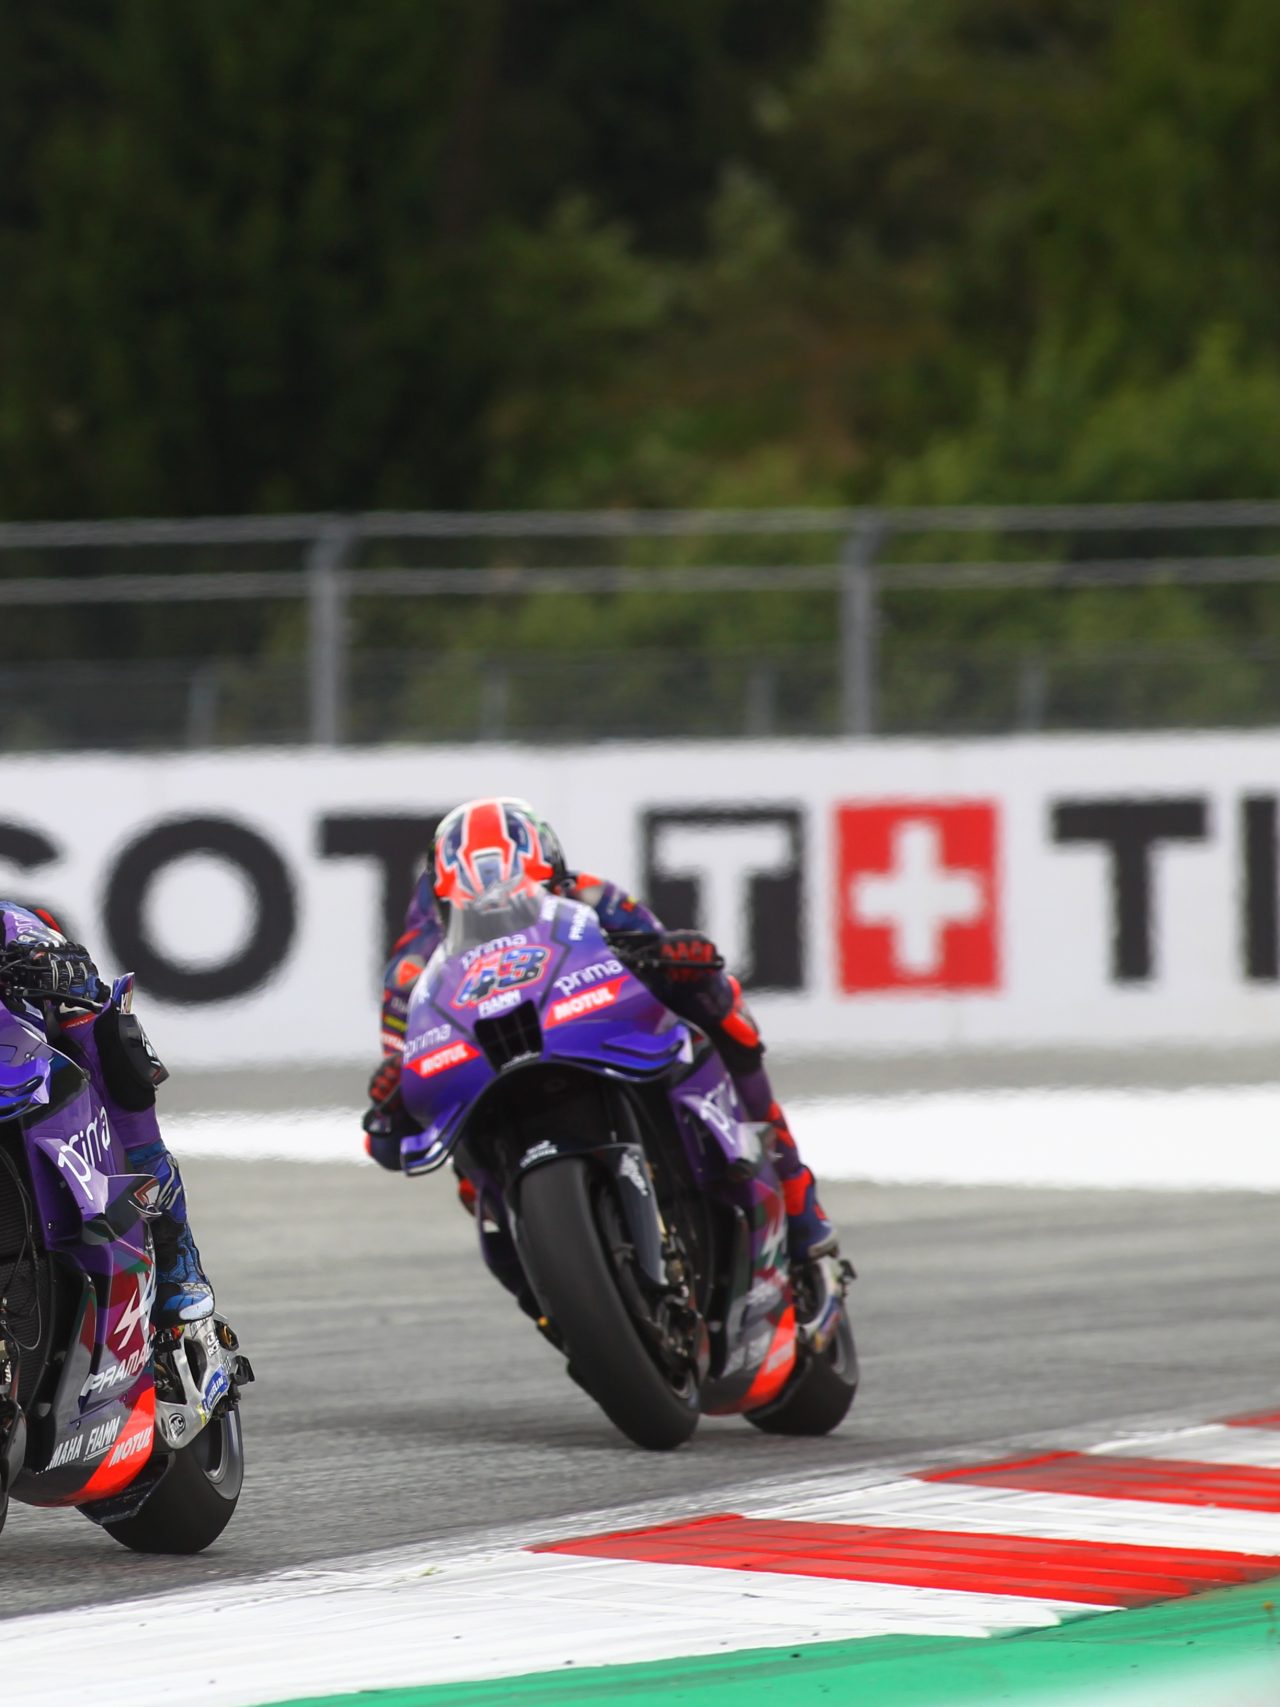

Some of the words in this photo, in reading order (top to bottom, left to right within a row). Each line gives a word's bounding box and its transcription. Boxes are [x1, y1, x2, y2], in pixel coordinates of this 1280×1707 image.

[554, 959, 624, 997] prima
[553, 987, 616, 1020] MOTUL
[37, 1434, 83, 1473] MAHA
[85, 1416, 120, 1456] FIAMM
[108, 1425, 153, 1468] MOTUL
